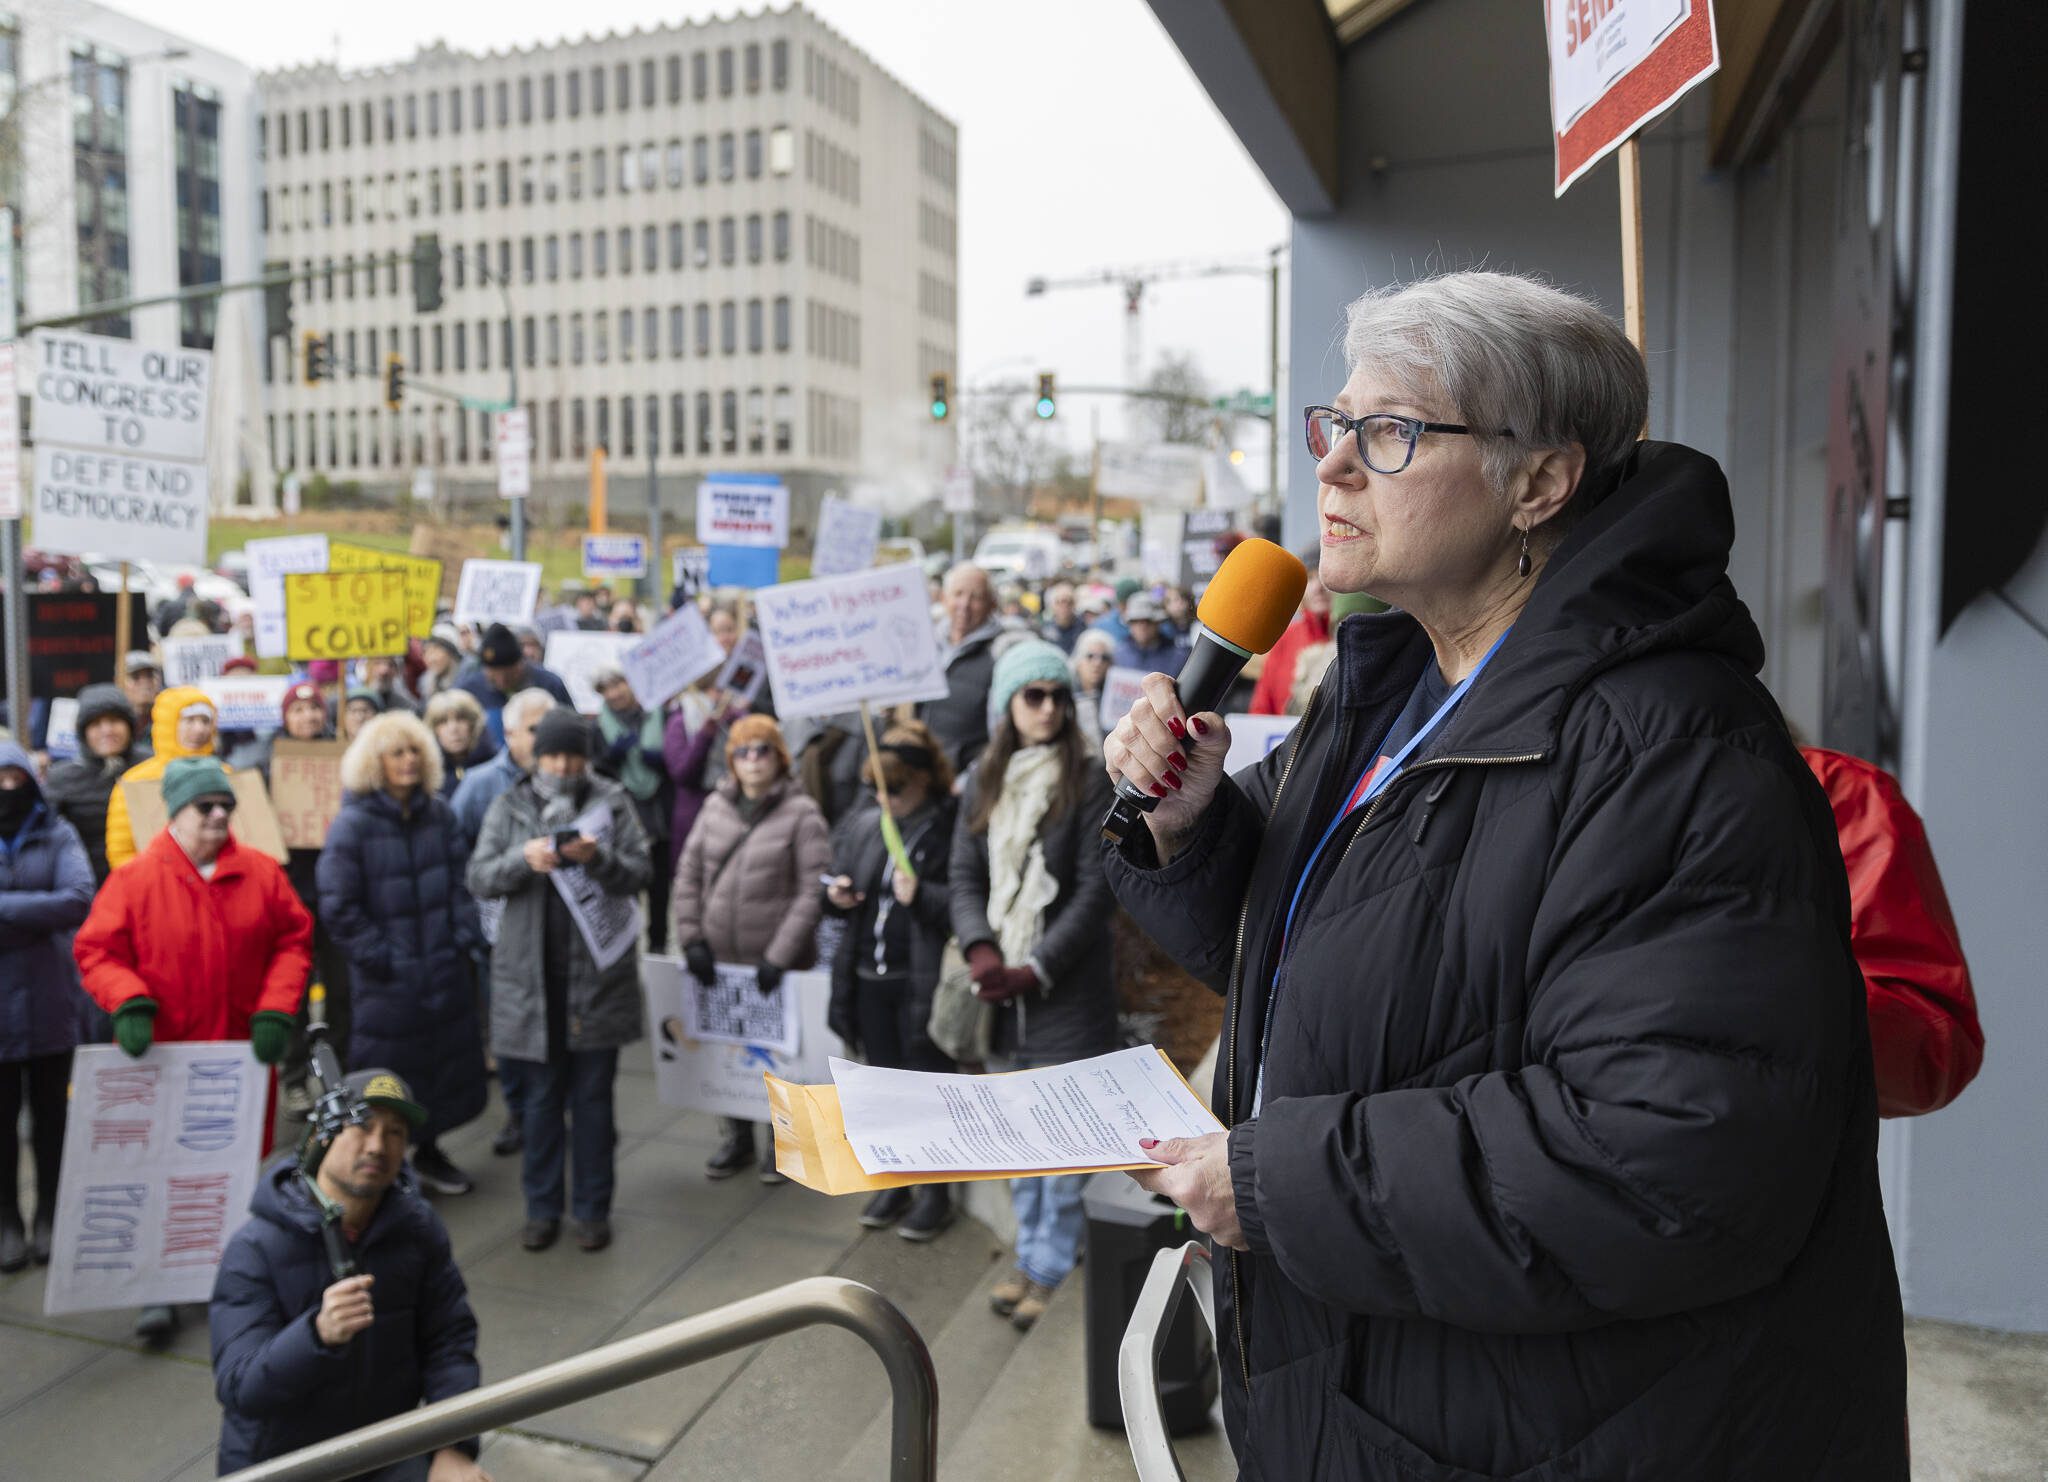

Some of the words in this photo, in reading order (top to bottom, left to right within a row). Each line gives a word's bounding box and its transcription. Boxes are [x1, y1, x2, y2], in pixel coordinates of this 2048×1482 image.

[42, 337, 118, 376] TELL
[142, 353, 205, 385] OUR
[37, 374, 200, 421] CONGRESS
[103, 415, 146, 448] TO
[51, 451, 193, 496] DEFEND
[40, 486, 200, 530] DEMOCRACY
[295, 572, 402, 604] STOP
[305, 618, 401, 656] COUP
[94, 1064, 162, 1112] FOR
[175, 1058, 243, 1151] DEFEND
[73, 1184, 147, 1272] PEOPLE
